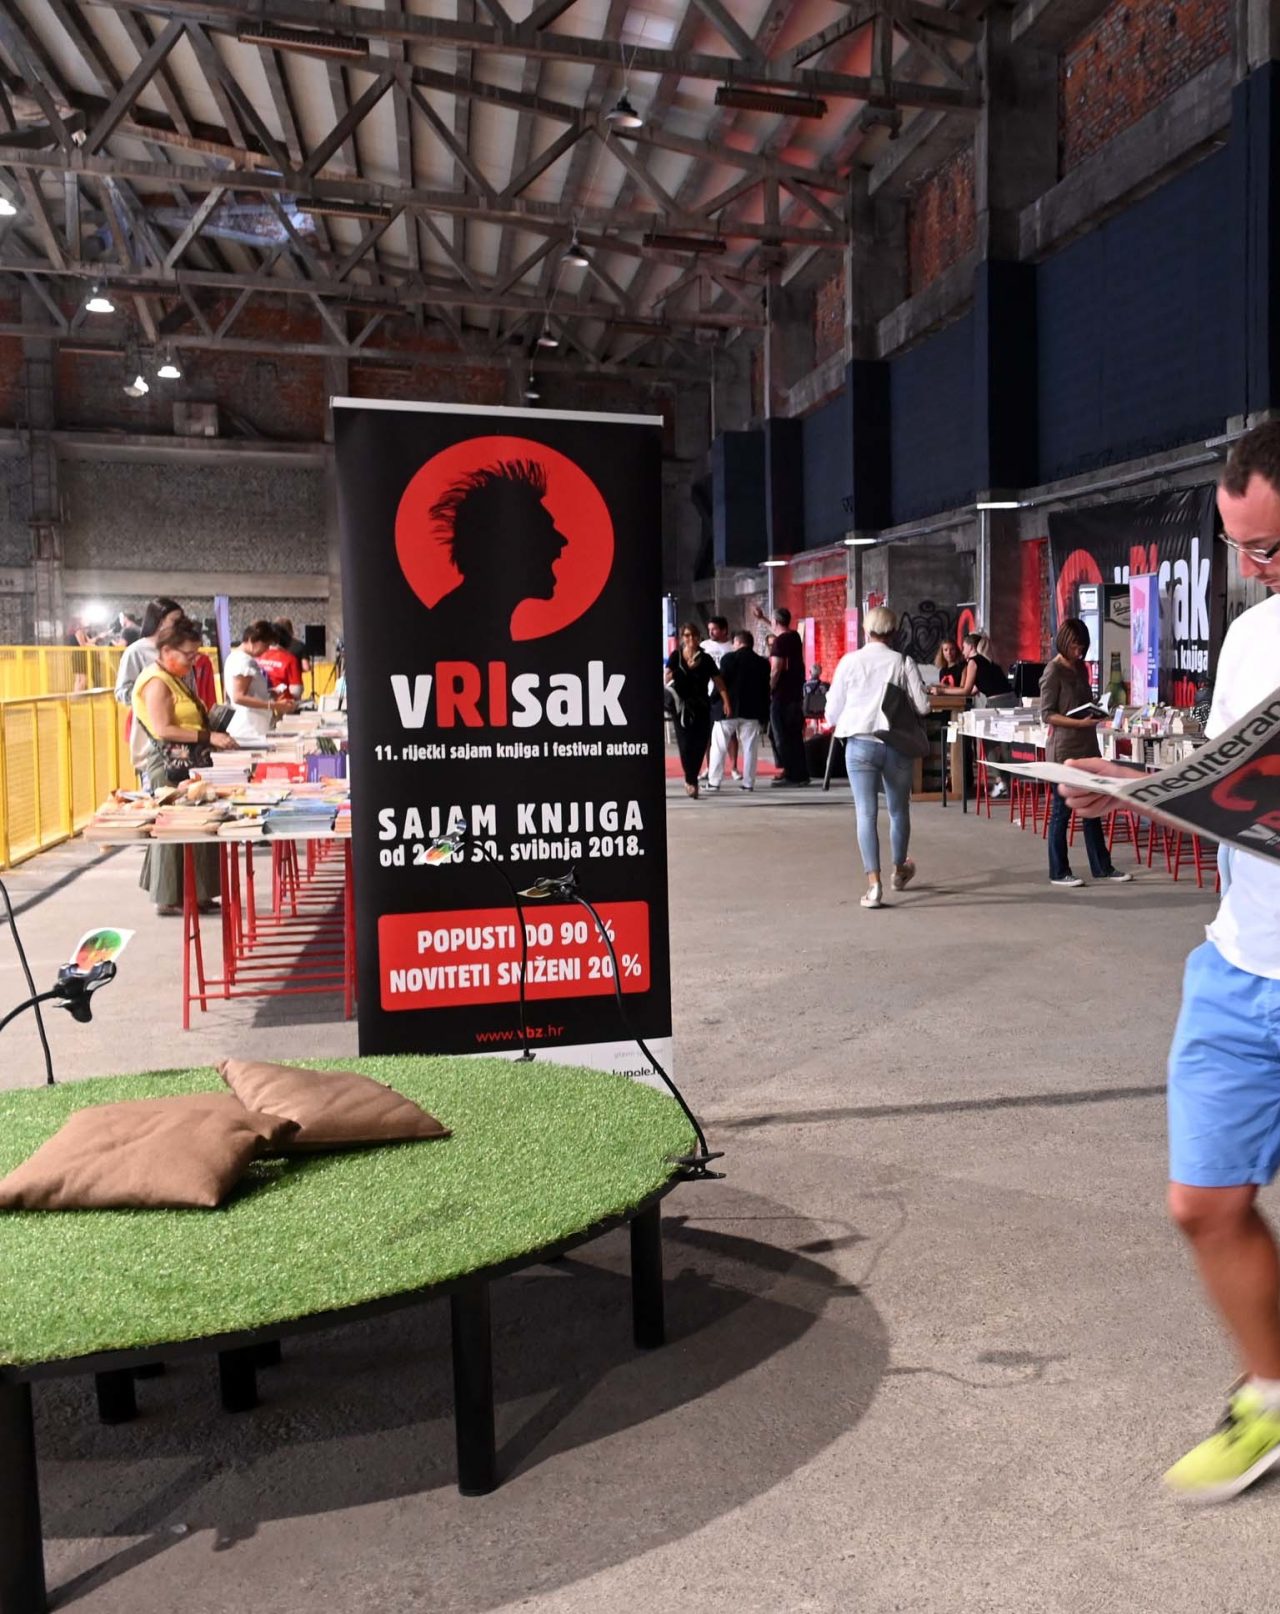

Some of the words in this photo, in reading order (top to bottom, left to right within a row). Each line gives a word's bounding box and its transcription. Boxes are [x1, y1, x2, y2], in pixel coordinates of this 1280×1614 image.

[1181, 645, 1208, 673] knjiga
[390, 660, 628, 729] vRIsak
[374, 745, 398, 761] 11.
[402, 743, 446, 762] riječki
[450, 743, 492, 760] sajam
[496, 742, 540, 759] knjiga
[543, 742, 548, 757] i
[552, 741, 602, 757] festival
[606, 742, 649, 756] autora
[378, 804, 497, 840] SAJAM
[517, 801, 644, 835] KNJIGA
[379, 844, 406, 867] od
[511, 838, 582, 862] svibnja
[589, 836, 645, 858] 2018.
[417, 925, 515, 954] POPUSTI
[524, 923, 553, 948] DO
[560, 921, 588, 946] 90
[389, 963, 490, 994] NOVITETI
[497, 956, 581, 985] SNIŽENI
[588, 956, 614, 979] 20
[621, 953, 642, 977] %
